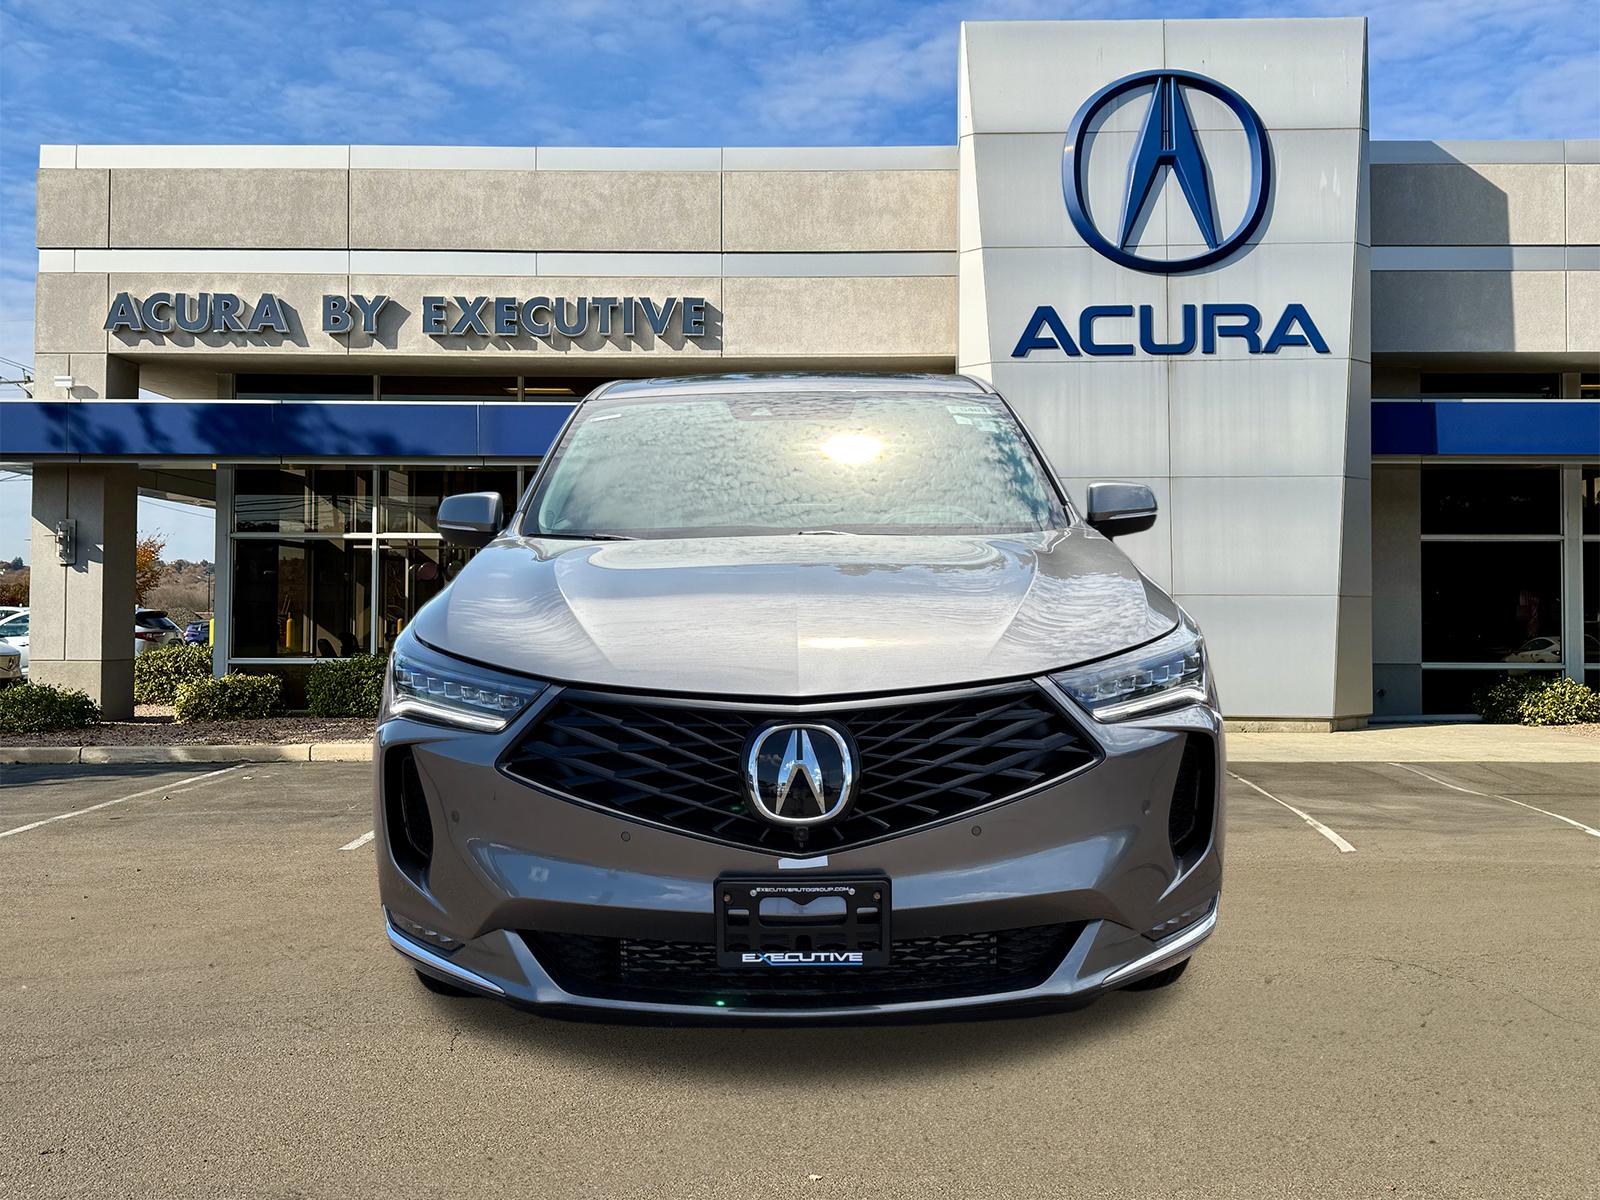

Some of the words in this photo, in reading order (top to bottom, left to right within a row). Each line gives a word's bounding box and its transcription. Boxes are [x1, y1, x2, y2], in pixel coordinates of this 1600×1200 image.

[103, 292, 289, 334] ACURA
[322, 295, 390, 334] BY
[422, 296, 706, 336] EXECUTIVE
[1011, 304, 1331, 357] ACURA
[742, 952, 863, 963] EXECUTIVE
